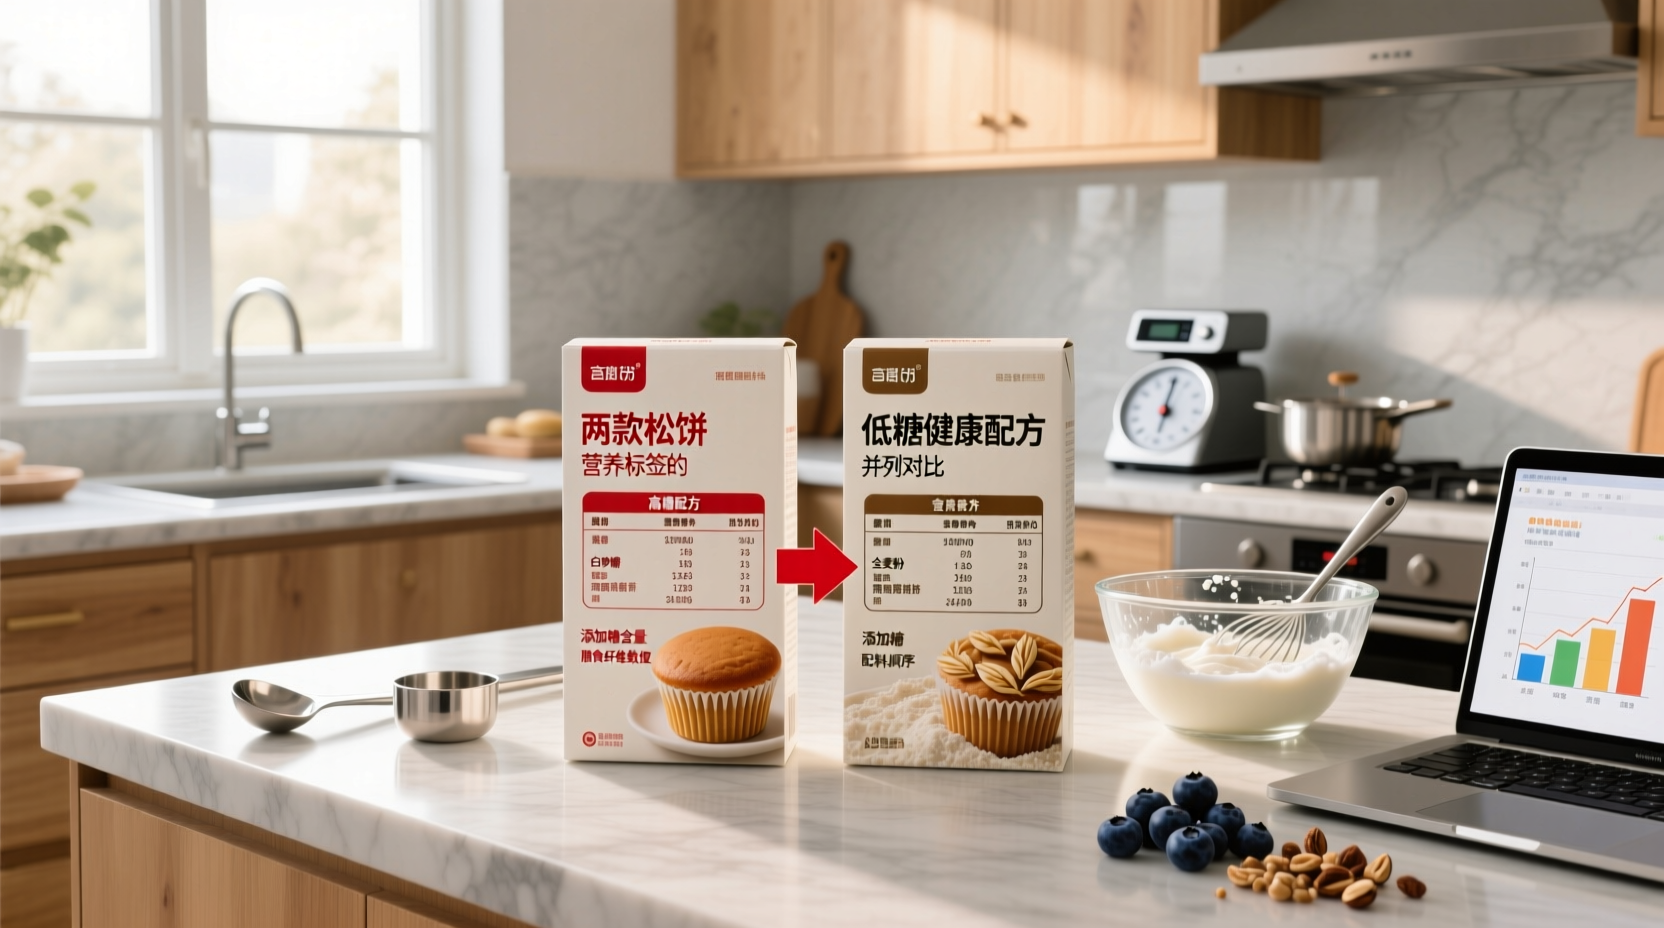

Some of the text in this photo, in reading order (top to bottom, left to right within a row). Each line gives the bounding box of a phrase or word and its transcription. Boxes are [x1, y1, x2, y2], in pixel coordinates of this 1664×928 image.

[581, 411, 708, 446] 两款松饼
[861, 412, 1046, 447] 低糖健康配方
[581, 452, 688, 477] 营养标签的
[861, 454, 945, 477] 并列对比
